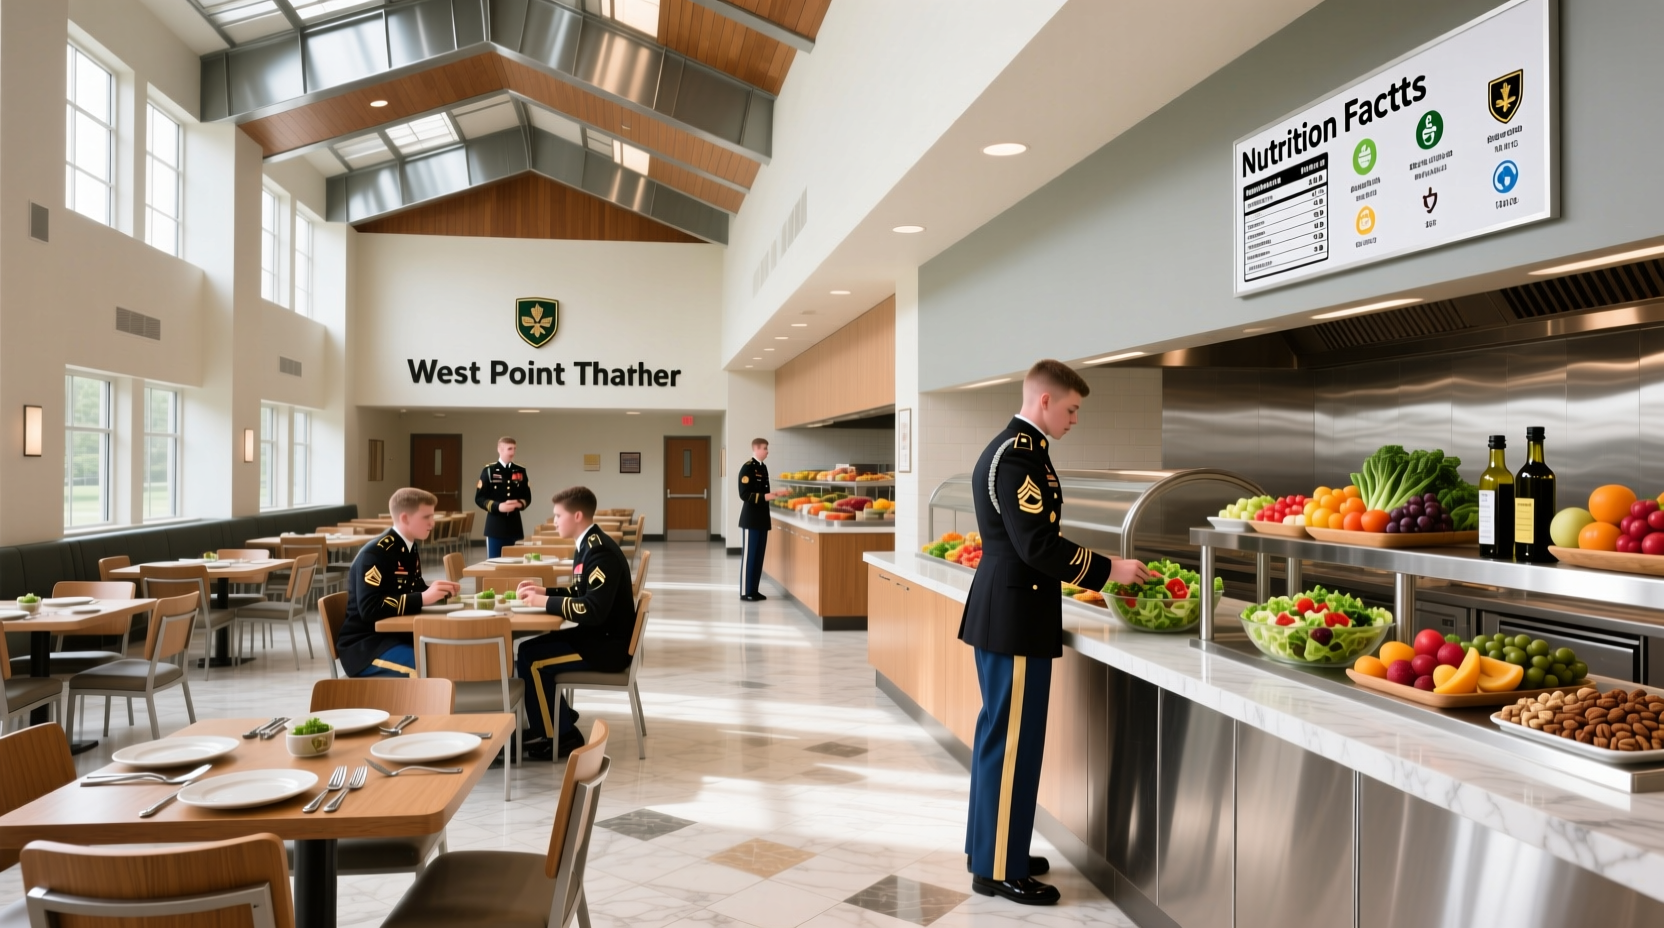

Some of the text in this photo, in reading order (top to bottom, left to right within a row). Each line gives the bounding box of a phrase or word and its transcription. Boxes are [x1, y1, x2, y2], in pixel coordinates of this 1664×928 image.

[1242, 75, 1427, 178] Nutrition Factts
[407, 359, 481, 384] West
[490, 360, 566, 386] Point
